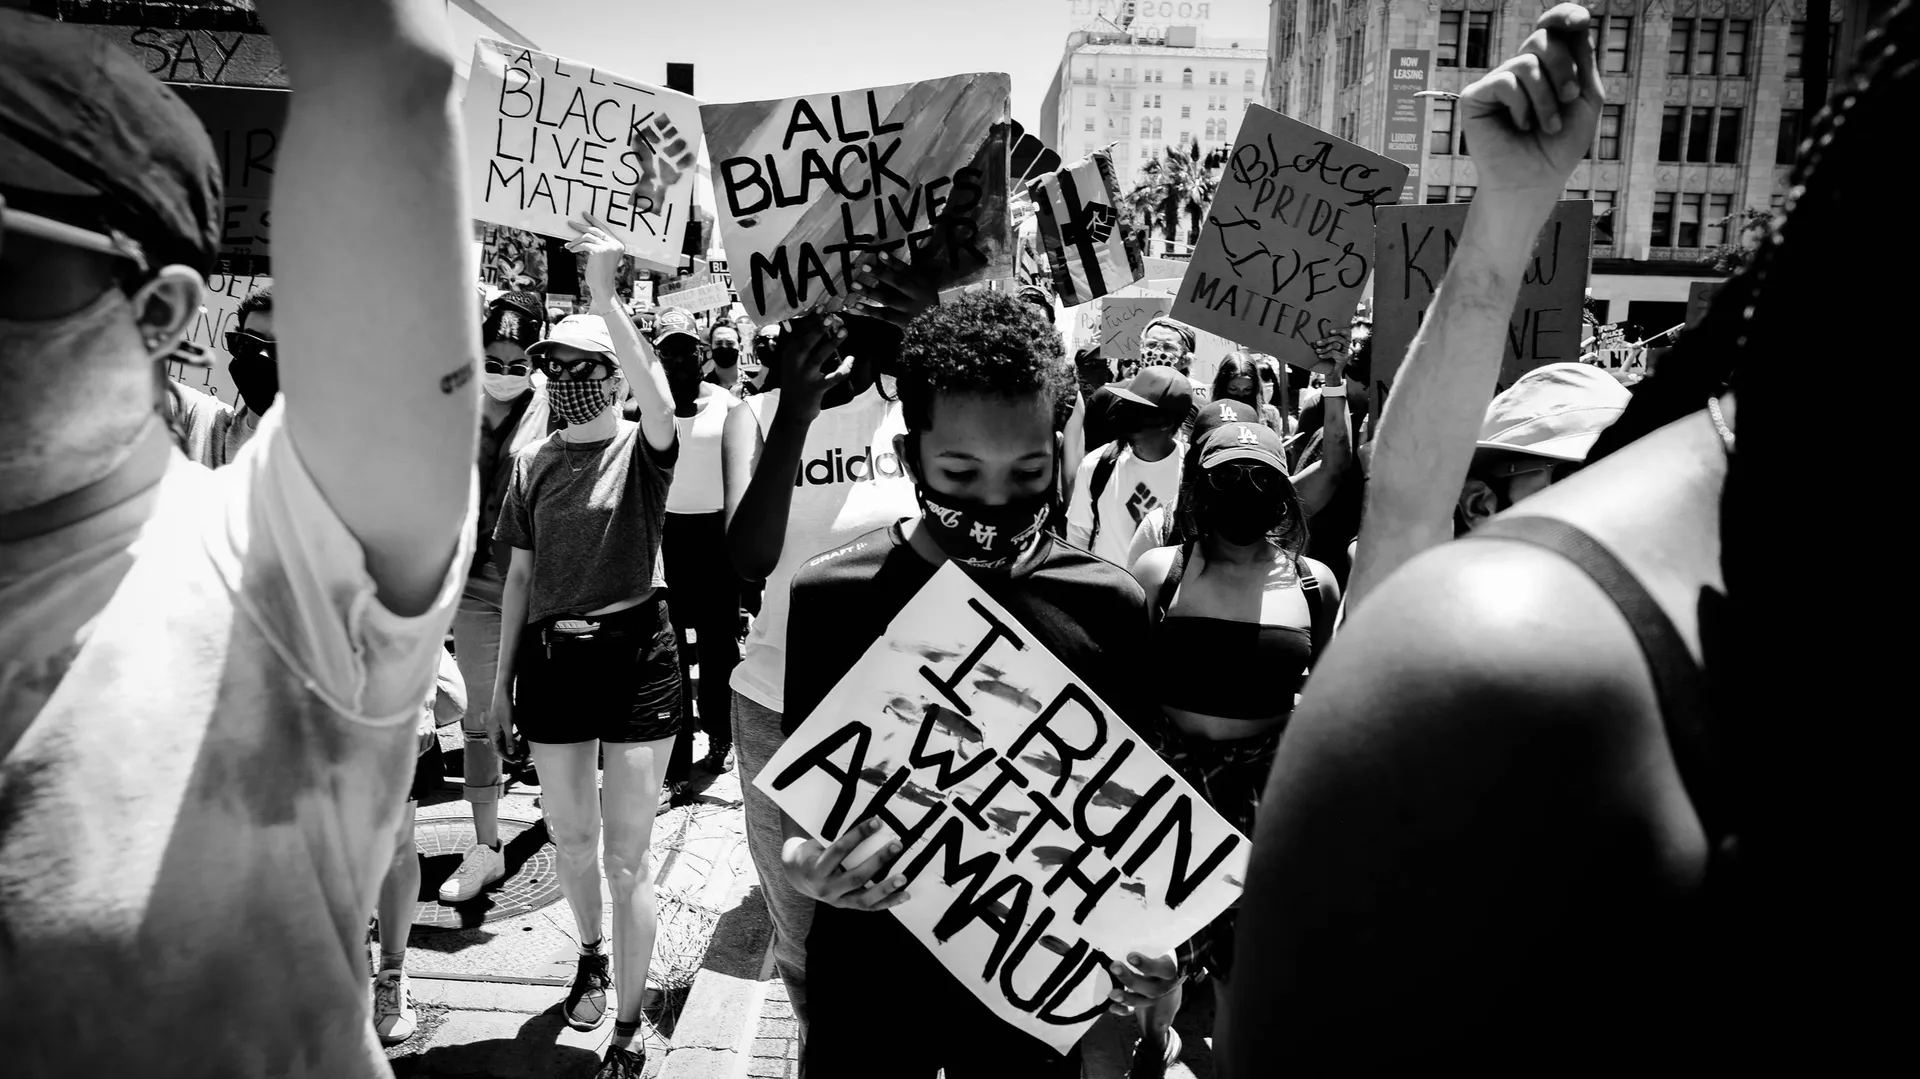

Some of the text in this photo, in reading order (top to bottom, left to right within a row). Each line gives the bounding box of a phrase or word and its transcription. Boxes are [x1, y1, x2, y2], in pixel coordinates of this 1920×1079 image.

[131, 27, 243, 83] SAY
[1393, 69, 1424, 80] LEASING
[1400, 57, 1418, 67] NOW
[499, 64, 657, 155] BLACK
[782, 90, 904, 150] ALL
[1391, 132, 1416, 143] LUXURY
[496, 118, 644, 186] LIVES
[720, 137, 910, 217] BLACK
[485, 159, 673, 243] MATTER!
[840, 166, 984, 244] LIVES
[1252, 177, 1350, 247] PRIDE
[1219, 403, 1238, 422] LA
[1237, 426, 1259, 445] LA
[810, 546, 855, 567] CRAFT
[918, 598, 1027, 716] I
[907, 703, 1121, 925] WITH
[1006, 682, 1241, 910] RUN
[771, 720, 1126, 1026] AHMAUD
